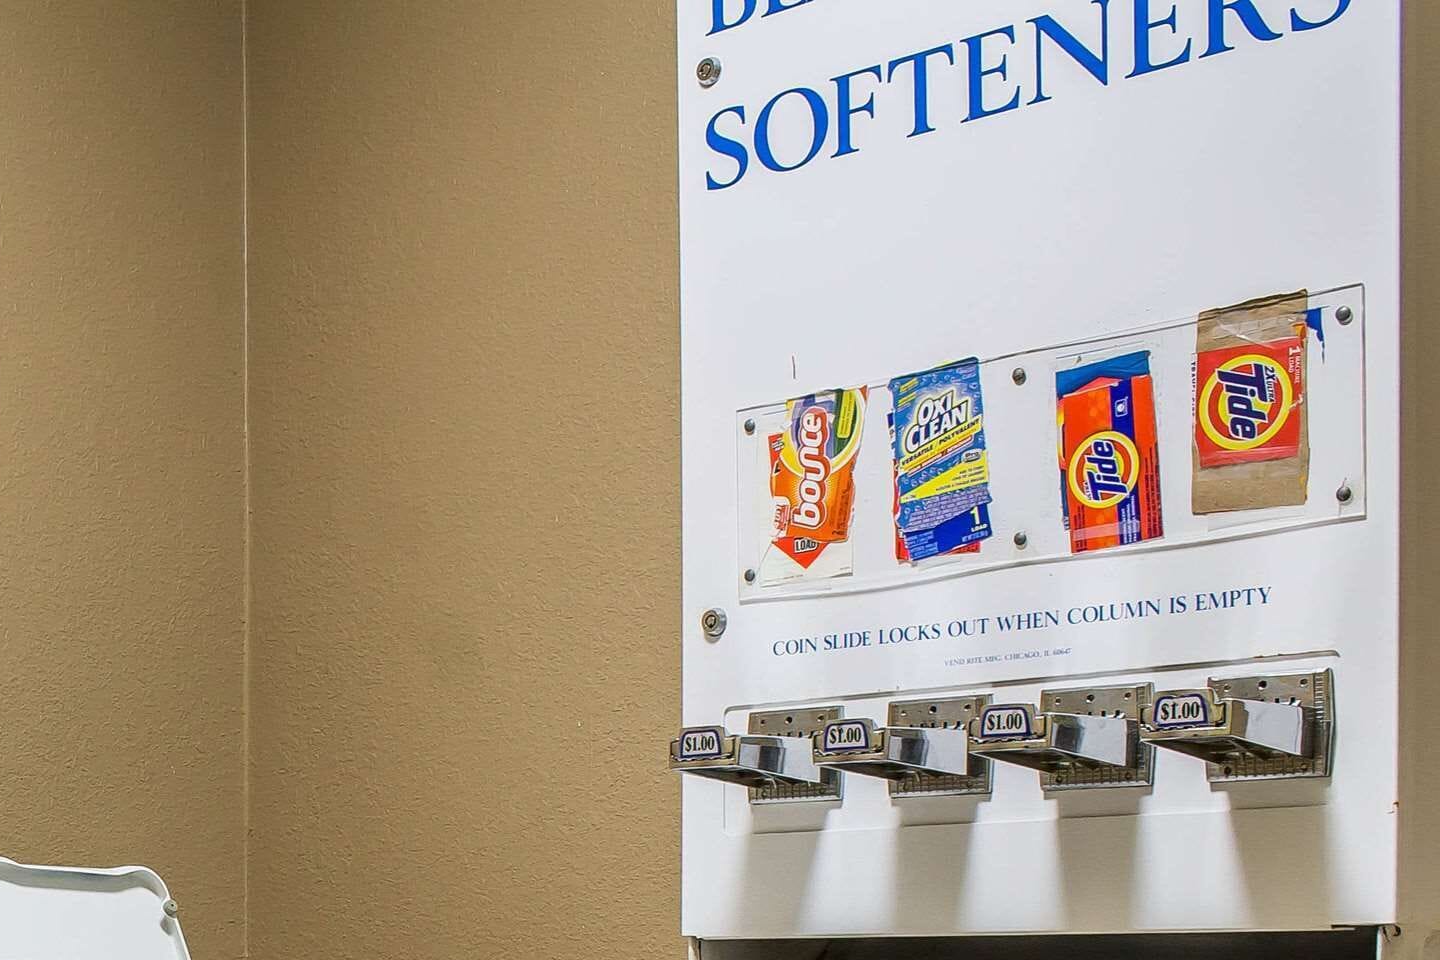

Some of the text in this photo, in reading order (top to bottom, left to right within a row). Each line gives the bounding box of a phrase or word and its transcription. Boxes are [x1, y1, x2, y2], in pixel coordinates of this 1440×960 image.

[918, 390, 954, 426] OXI
[1216, 362, 1268, 440] Tide
[906, 399, 968, 453] CLEAN
[791, 408, 826, 529] bounce
[1086, 438, 1129, 502] Tide
[970, 506, 981, 525] 1
[773, 586, 1272, 657] COIN SLIDE LOCKS OUT WHEN COLUMN IS EMPTY
[987, 713, 1022, 731] $1.00
[1161, 701, 1200, 721] $1.00
[685, 735, 715, 752] $1.00
[829, 726, 861, 744] $1.00
